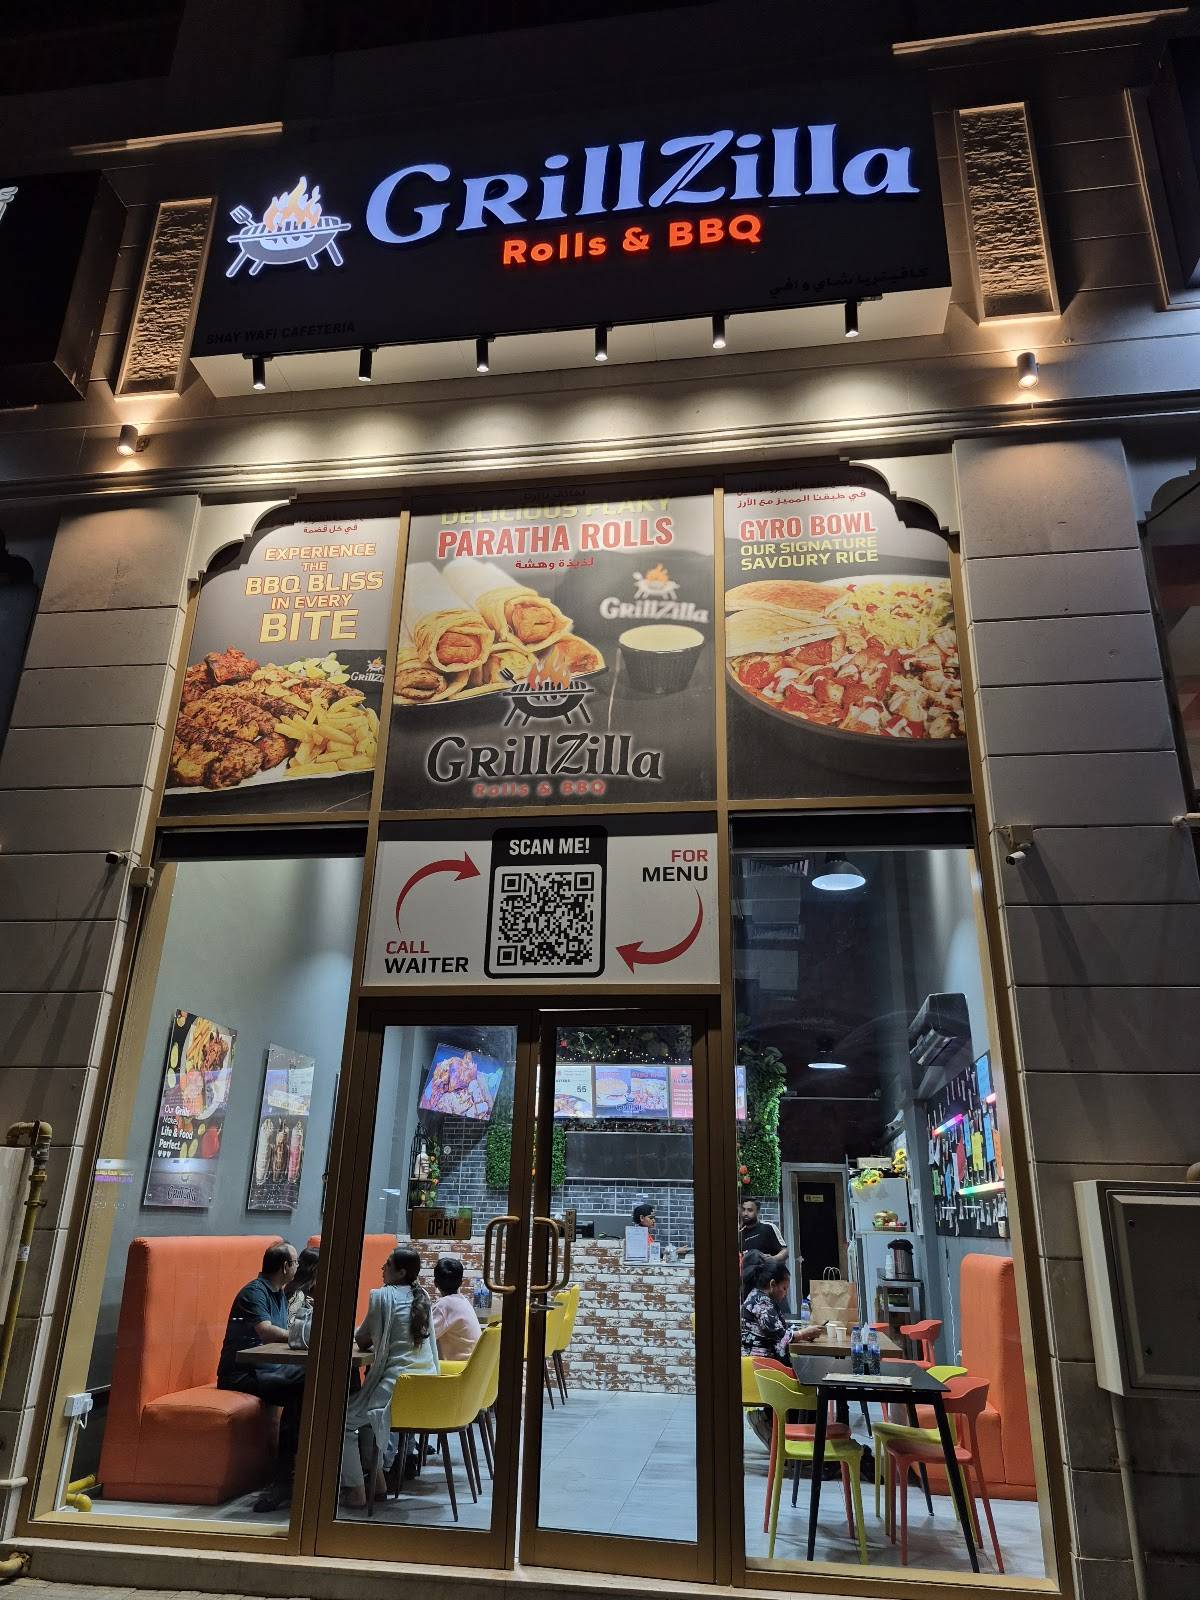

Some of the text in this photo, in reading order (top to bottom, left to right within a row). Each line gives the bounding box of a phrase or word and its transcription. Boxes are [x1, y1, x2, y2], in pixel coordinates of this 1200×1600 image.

[502, 213, 763, 266] Rolls & BBQ
[207, 321, 356, 345] SHAY WAFI CAFETERIA
[740, 511, 877, 543] GYRO BOWL
[437, 516, 674, 559] PARATHA ROLLS
[741, 536, 878, 556] OUR SIGNATURE
[265, 542, 377, 561] EXPERIENCE
[741, 549, 879, 571] SAVOURY RICE
[303, 561, 328, 572] THE
[245, 570, 385, 596] BBQ BLISS
[271, 593, 353, 610] IN EVERY
[259, 609, 359, 643] BITE
[473, 779, 606, 798] Rolls & BBQ
[508, 837, 591, 855] SCAN ME!
[671, 849, 708, 863] FOR
[642, 865, 708, 882] MENU
[385, 940, 430, 955] CALL
[384, 957, 469, 974] WAITER
[427, 1218, 457, 1237] OPEN
